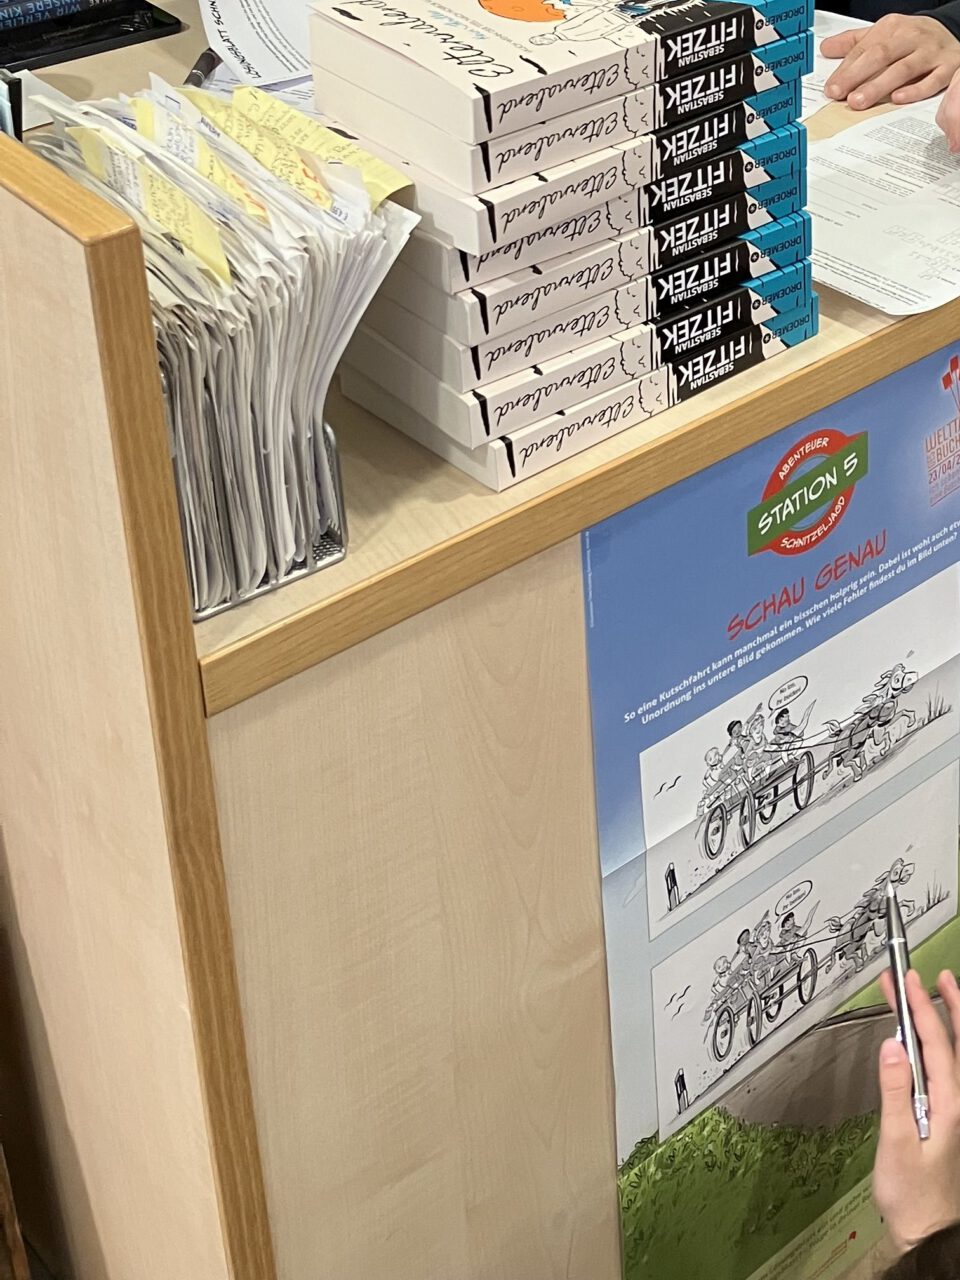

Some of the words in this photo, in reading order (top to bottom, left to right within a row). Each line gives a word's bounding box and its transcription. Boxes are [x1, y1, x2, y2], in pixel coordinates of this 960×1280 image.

[56, 3, 81, 17] WIR
[764, 5, 805, 26] DROEMER
[666, 18, 737, 62] FITZEK
[678, 44, 725, 67] SEBASTIAN
[764, 50, 805, 72] DROEMER
[497, 63, 620, 123] Elternabend
[665, 64, 737, 109] FITZEK
[677, 90, 724, 115] SEBASTIAN
[755, 96, 793, 120] DROEMER
[496, 112, 618, 174] Elternabend
[662, 113, 729, 161] FITZEK
[673, 139, 718, 166] SEBASTIAN
[754, 146, 797, 169] DROEMER
[502, 165, 618, 234] Elternabend
[650, 160, 725, 207] FITZEK
[663, 187, 713, 212] SEBASTIAN
[756, 186, 798, 211] DROEMER
[660, 203, 731, 252] FITZEK
[672, 230, 719, 257] SEBASTIAN
[759, 235, 802, 259] DROEMER
[493, 258, 614, 326] Elternabend
[659, 252, 732, 300] FITZEK
[670, 277, 719, 305] SEBASTIAN
[762, 281, 803, 305] DROEMER
[485, 305, 610, 372] Elternabend
[663, 300, 734, 350] FITZEK
[674, 326, 722, 354] SEBASTIAN
[771, 313, 811, 339] DROEMER
[679, 335, 746, 387] FITZEK
[690, 362, 735, 391] SEBASTIAN
[494, 356, 616, 426] Elternabend
[519, 395, 635, 468] Elternabend
[778, 436, 830, 480] ABENTEUER
[757, 468, 839, 535] STATION
[843, 452, 859, 477] 5
[781, 495, 845, 549] SCHNITZELJAGD
[727, 576, 805, 640] SCHAU
[815, 529, 887, 591] GENAU
[623, 711, 636, 724] So
[637, 699, 658, 715] eine
[659, 667, 711, 701] Kutschfahrt
[711, 653, 733, 671] kann
[734, 627, 778, 658] manchmal
[779, 619, 792, 632] ein
[793, 598, 829, 624] bisschen
[829, 580, 859, 601] holprig
[859, 570, 877, 584] sein.
[878, 554, 900, 573] Dabei
[901, 546, 911, 558] ist
[912, 538, 930, 554] wohl
[931, 527, 948, 543] auch
[641, 691, 692, 725] Unordnung
[693, 683, 706, 695] ins
[707, 665, 736, 686] untere
[737, 652, 754, 668] Bild
[755, 627, 804, 659] gekommen.
[805, 614, 822, 629] Wie
[822, 600, 842, 617] viele
[843, 587, 868, 606] Fehler
[869, 570, 895, 593] findest
[896, 562, 906, 574] du
[907, 557, 917, 568] im
[918, 547, 933, 562] Bild
[934, 532, 958, 552] unten?
